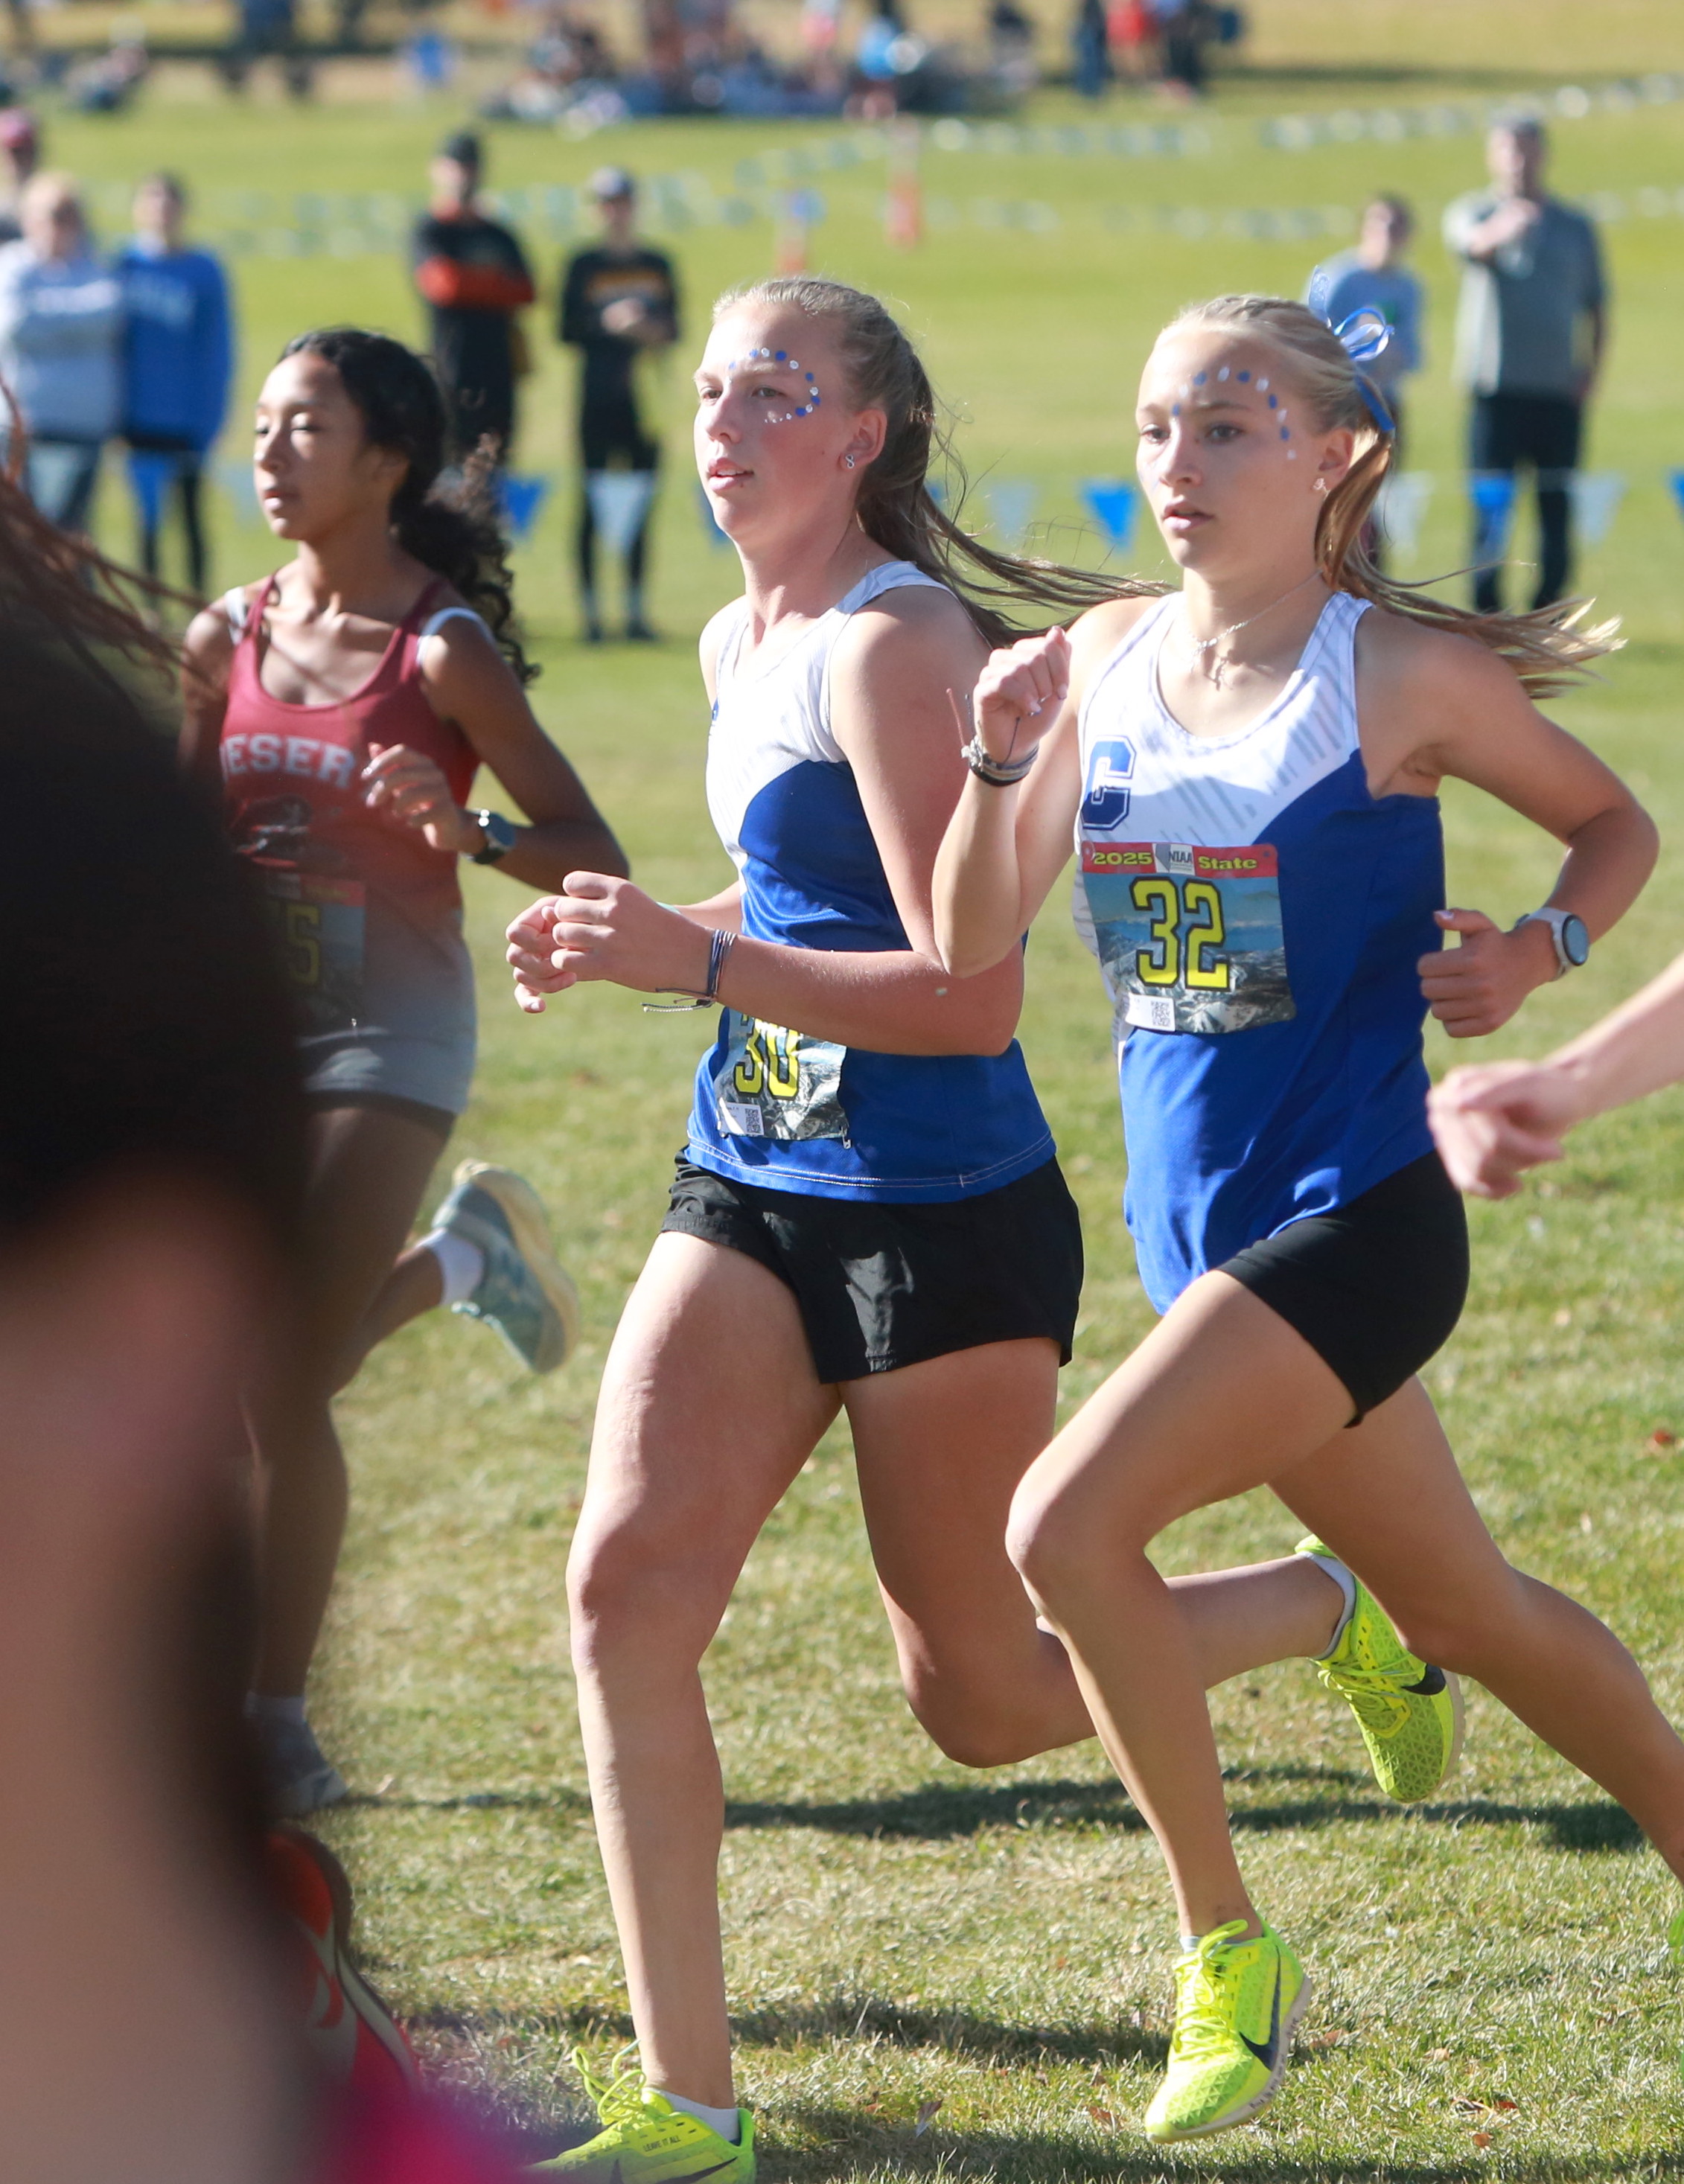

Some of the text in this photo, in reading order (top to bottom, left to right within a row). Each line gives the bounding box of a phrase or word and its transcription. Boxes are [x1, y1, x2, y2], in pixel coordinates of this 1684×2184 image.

[220, 732, 356, 789] ESER
[1094, 852, 1153, 866] 2025
[1168, 851, 1193, 863] NIAA
[1199, 855, 1258, 870] State
[272, 902, 321, 986] 5
[1130, 876, 1231, 992] 32
